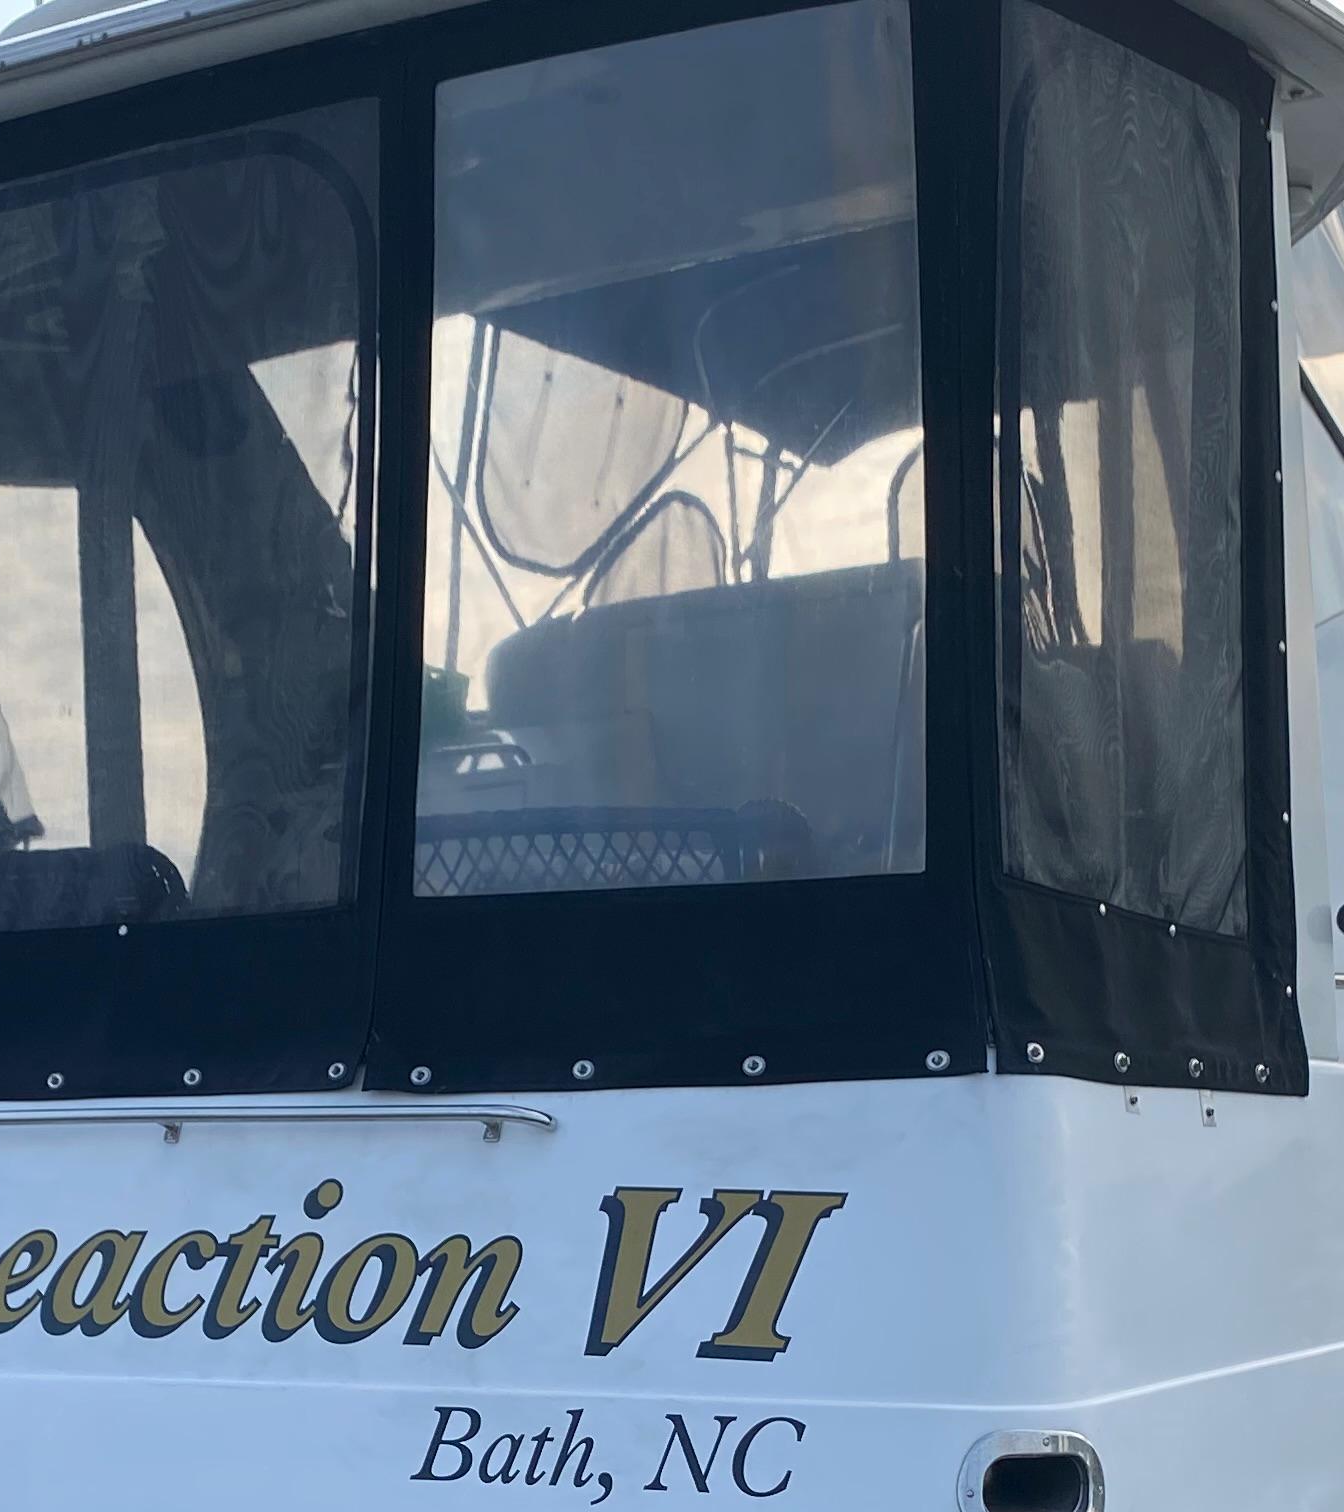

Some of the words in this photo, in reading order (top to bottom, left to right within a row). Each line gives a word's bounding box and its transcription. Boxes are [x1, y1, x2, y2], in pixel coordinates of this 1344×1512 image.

[584, 1186, 849, 1362] VI
[409, 1406, 614, 1506] Bath,
[643, 1414, 807, 1498] NC
